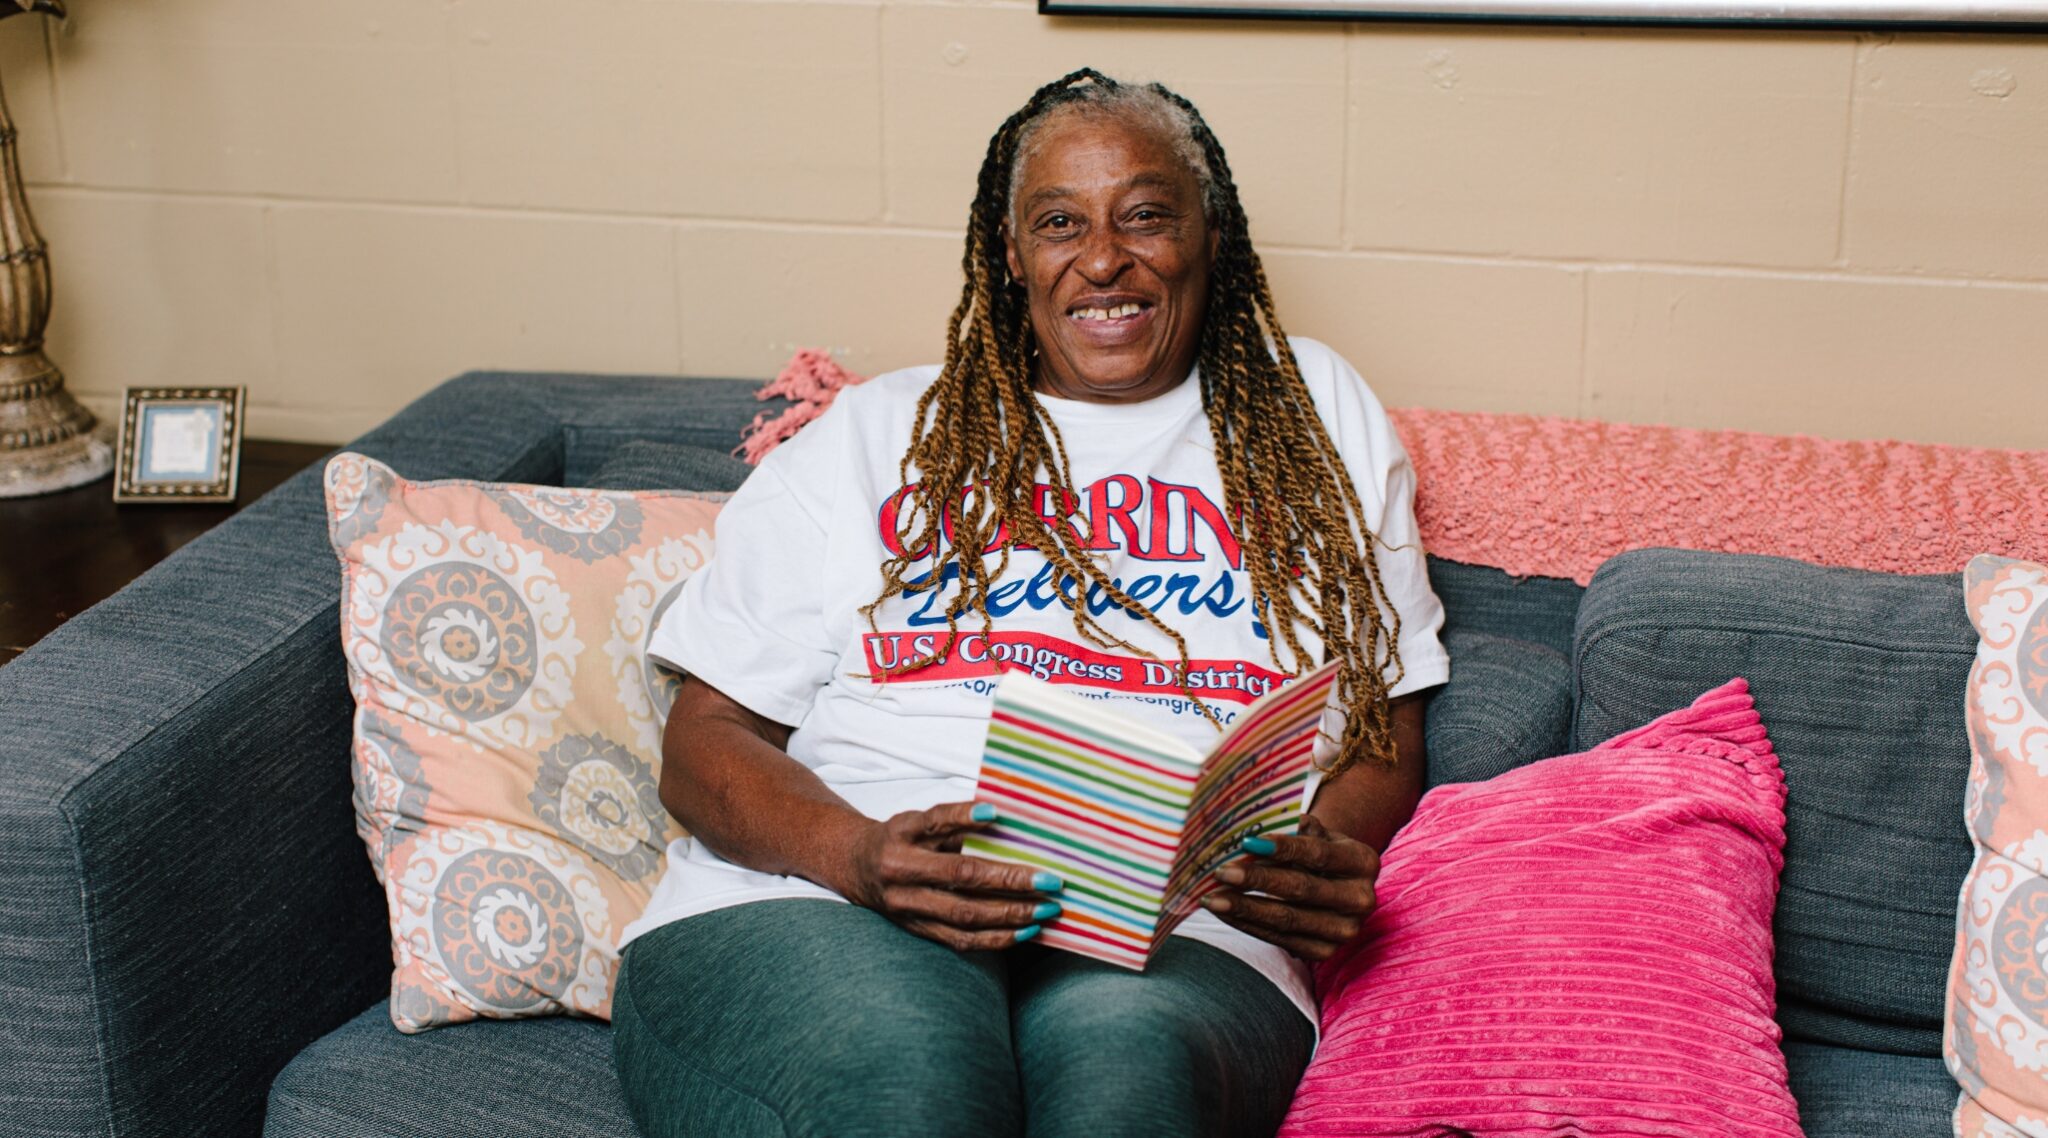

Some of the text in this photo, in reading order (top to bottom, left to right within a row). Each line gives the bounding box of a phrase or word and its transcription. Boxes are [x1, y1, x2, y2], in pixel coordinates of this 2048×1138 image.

[878, 473, 1305, 580] CORRIN
[867, 634, 1273, 698] U.S. Congress District
